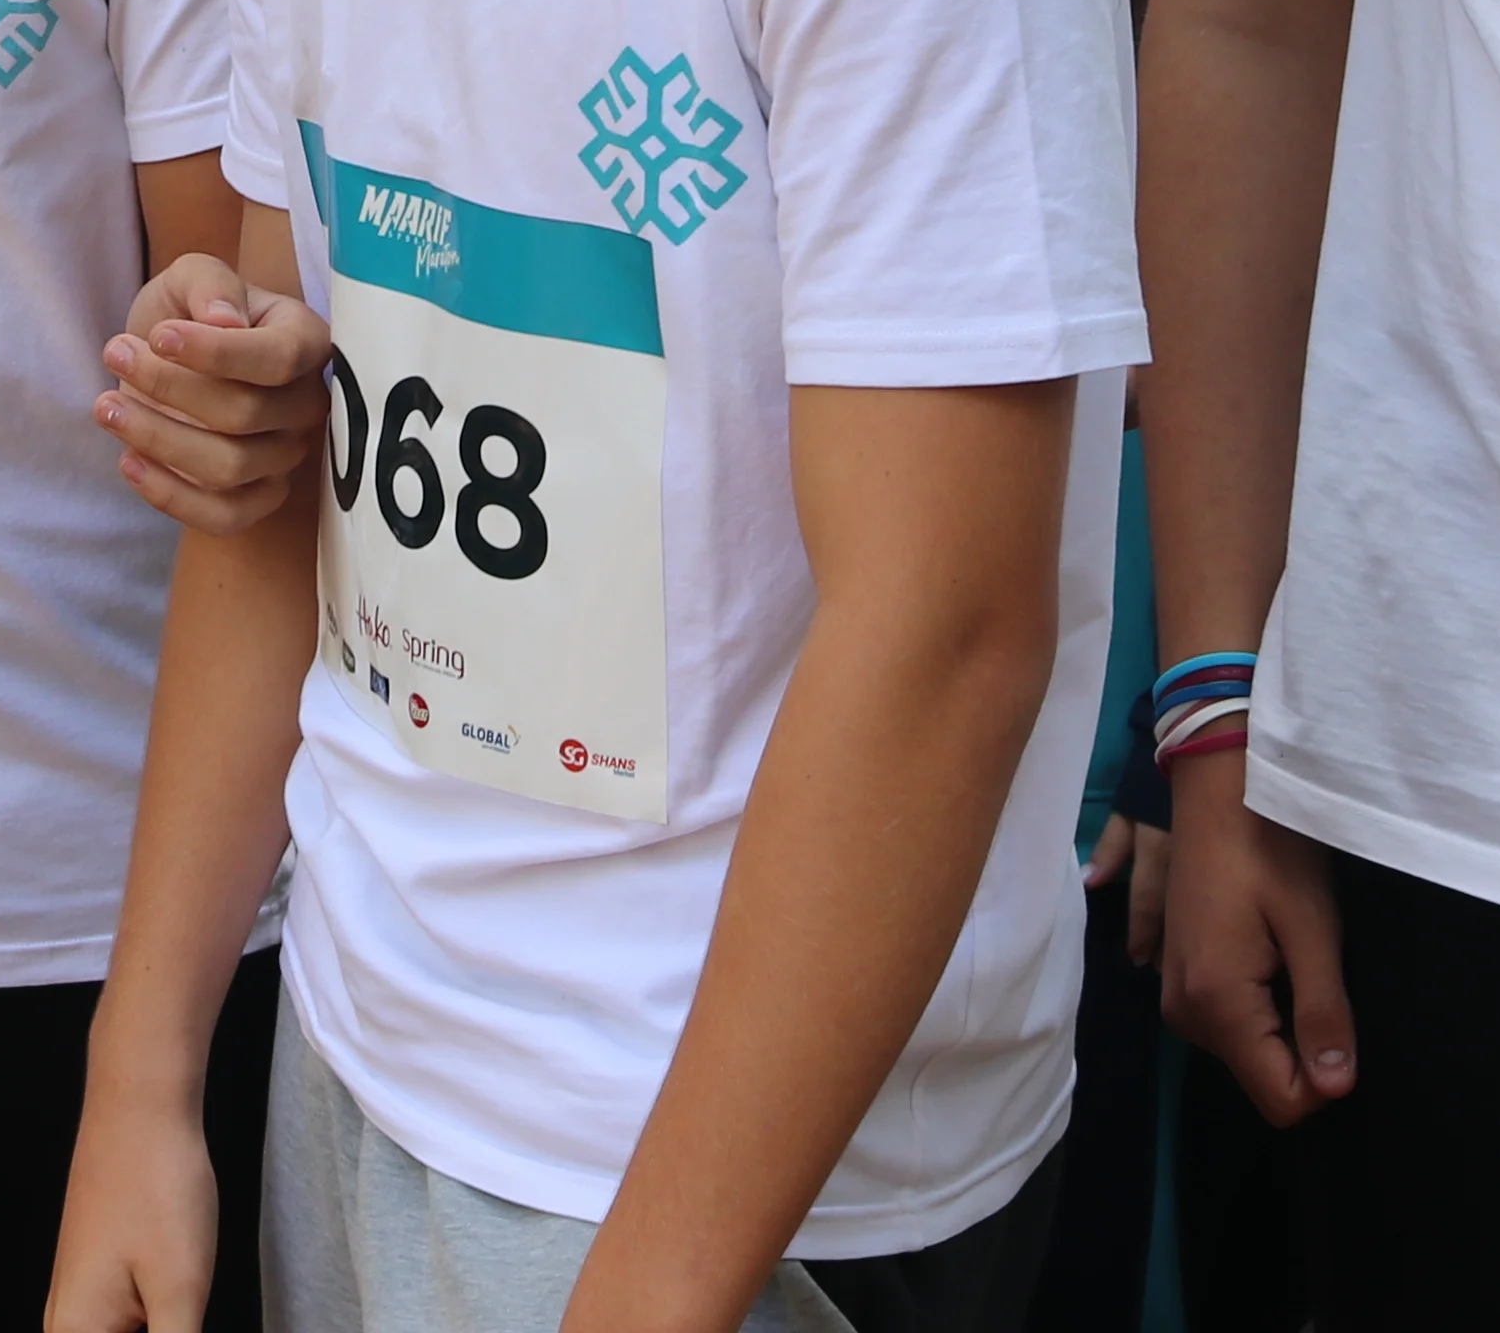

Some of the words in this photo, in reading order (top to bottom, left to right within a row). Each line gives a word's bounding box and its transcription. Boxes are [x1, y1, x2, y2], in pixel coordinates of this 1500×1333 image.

[359, 184, 452, 245] MAARIF
[403, 629, 464, 679] Spring
[461, 722, 511, 749] GLOBAL
[591, 754, 636, 771] SHANS
